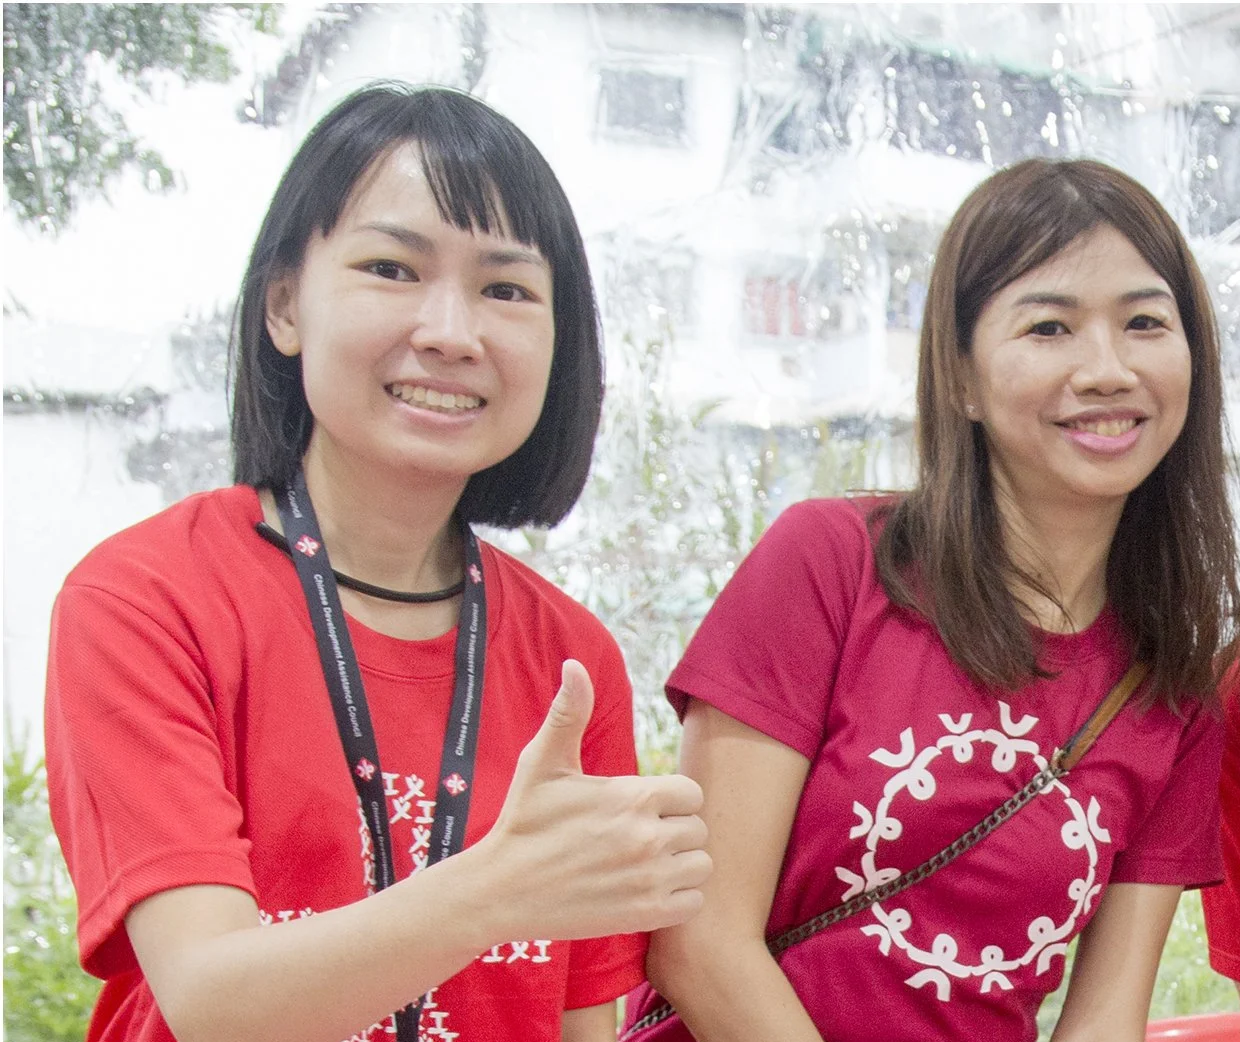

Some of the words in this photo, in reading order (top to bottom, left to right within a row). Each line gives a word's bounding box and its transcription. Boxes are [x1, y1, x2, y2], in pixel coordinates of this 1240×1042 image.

[469, 602, 479, 632] Council
[313, 573, 329, 606] Chinese
[322, 606, 344, 659] Development
[336, 659, 354, 705] Assistance
[347, 705, 363, 738] Council
[466, 633, 477, 673] Assistance
[460, 672, 475, 724] Development
[455, 724, 468, 757] Chinese
[441, 814, 455, 848] Council
